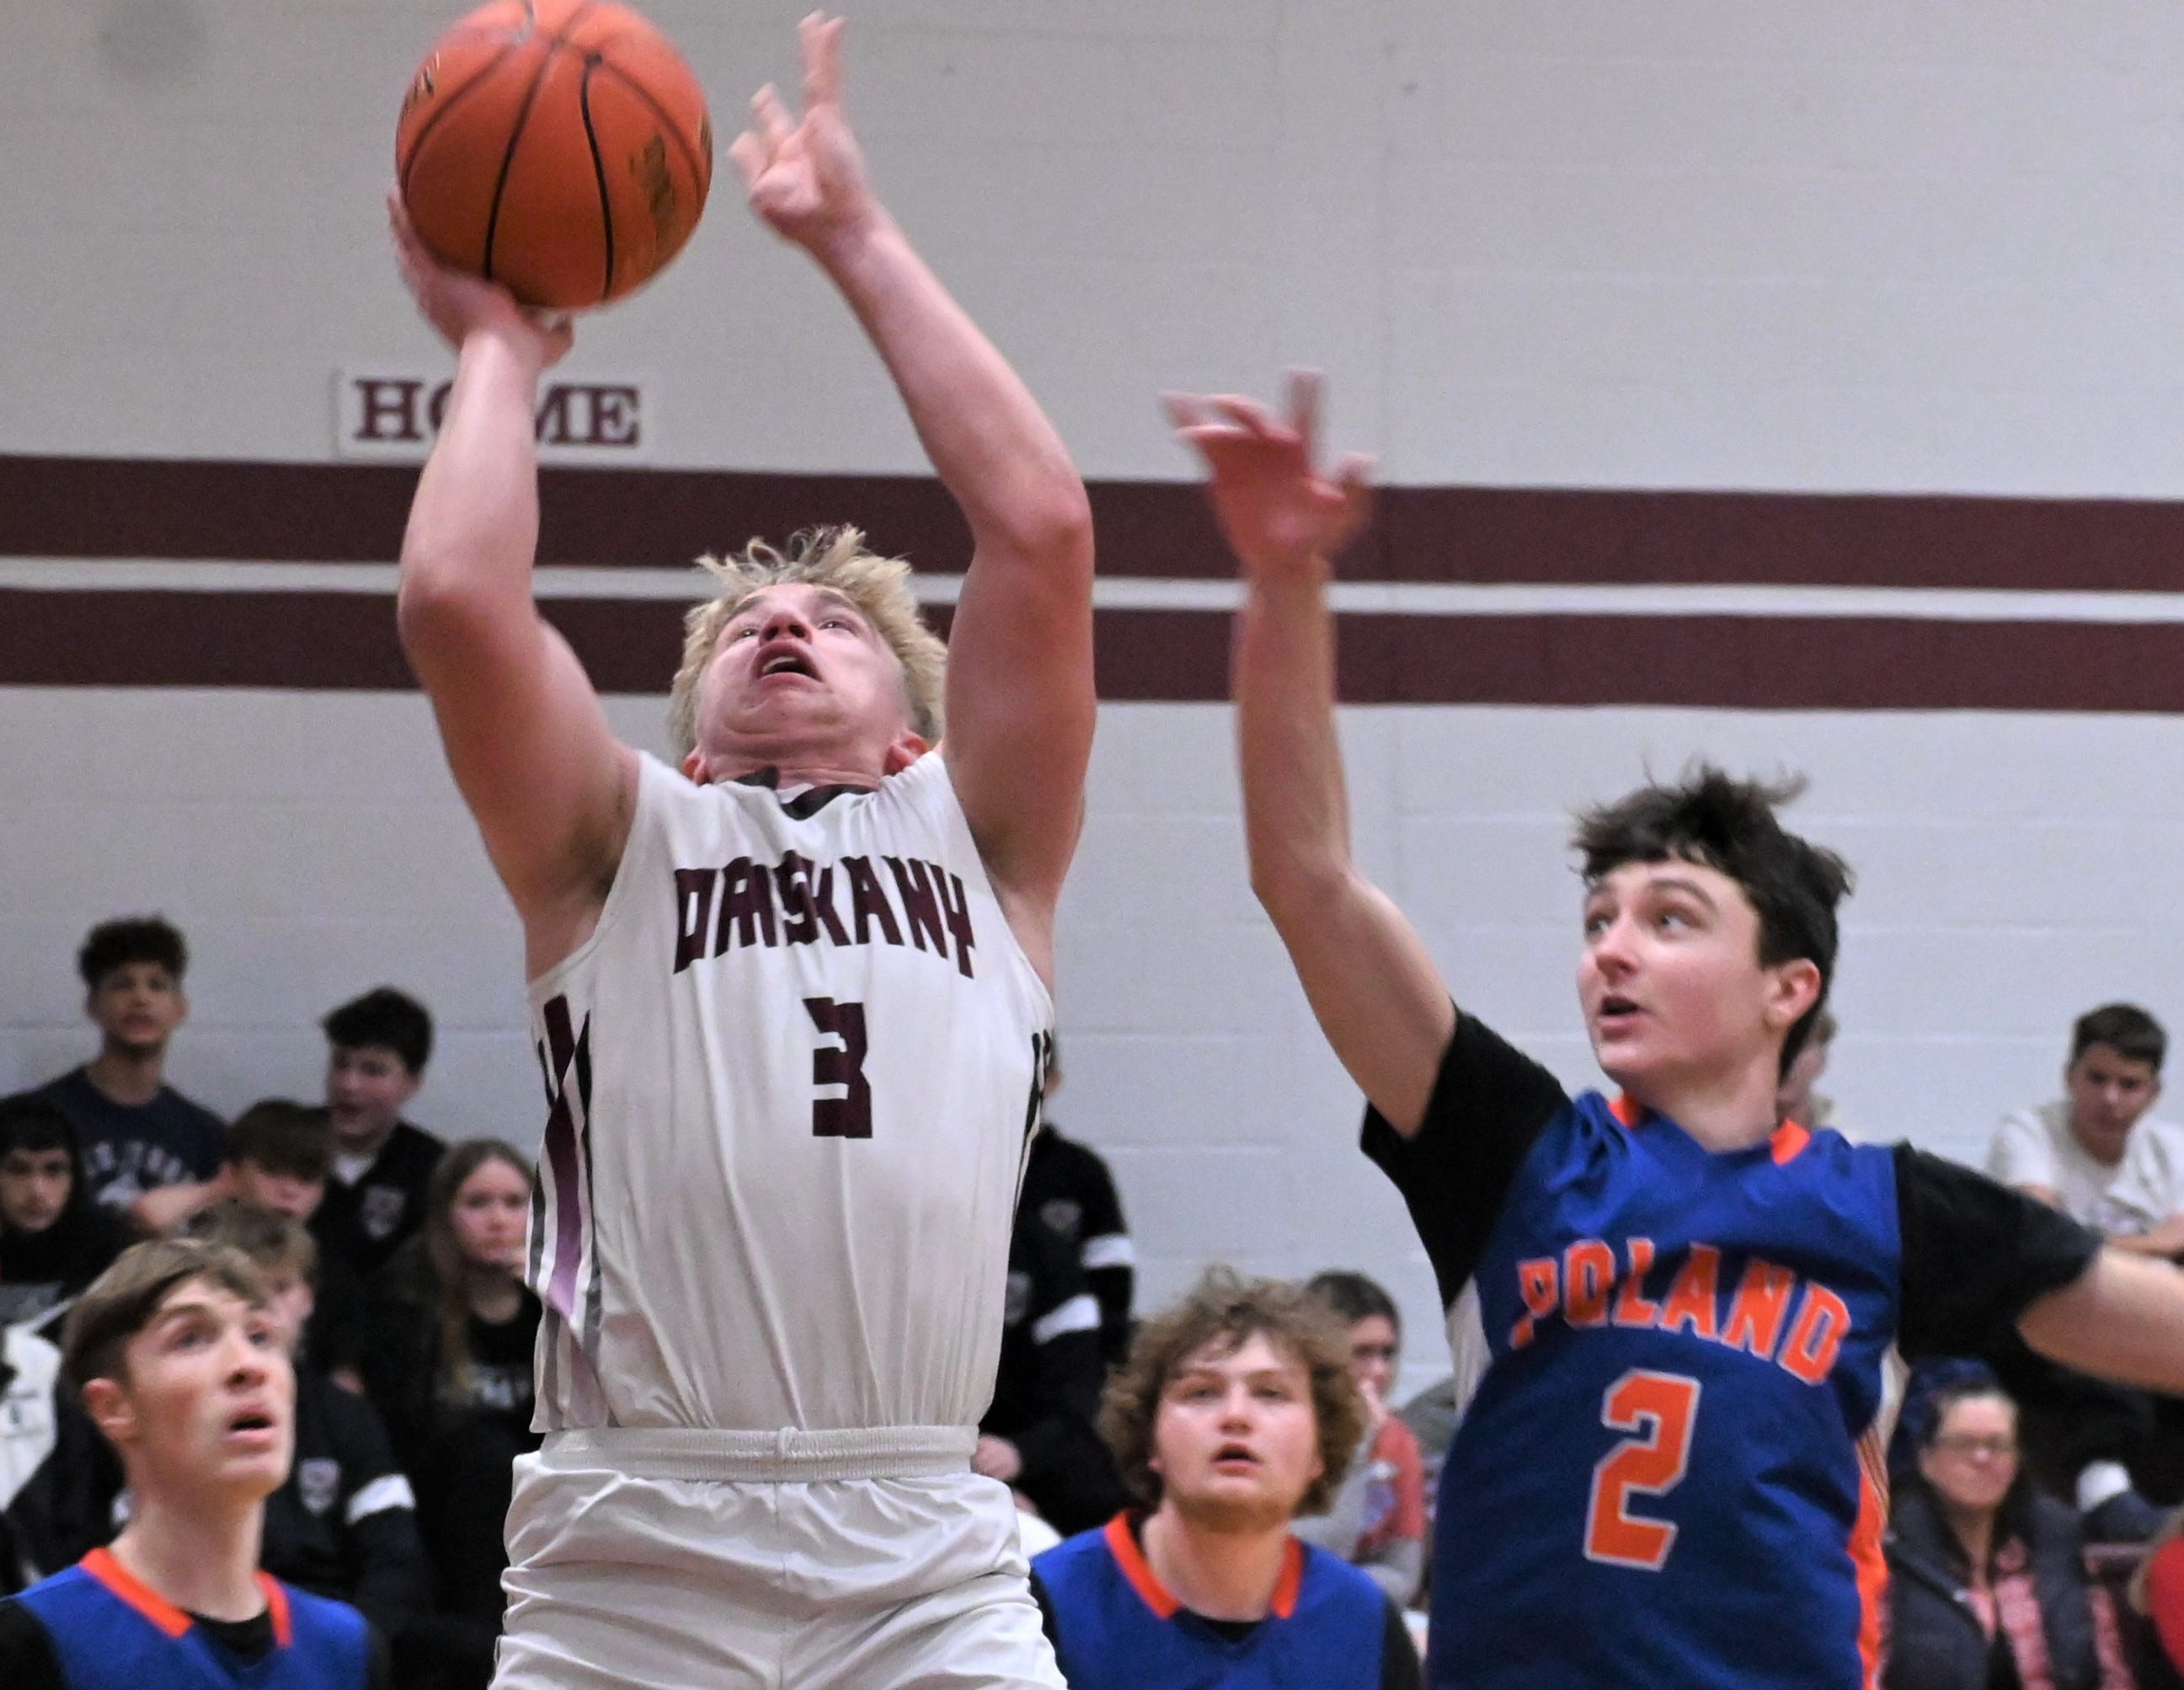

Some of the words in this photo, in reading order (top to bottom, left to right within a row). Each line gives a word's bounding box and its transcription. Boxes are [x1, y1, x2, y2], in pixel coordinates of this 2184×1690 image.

[354, 378, 640, 447] HME
[802, 997, 873, 1138] 3
[1509, 1237, 1851, 1386] POLAND
[1583, 1367, 1701, 1573] 2
